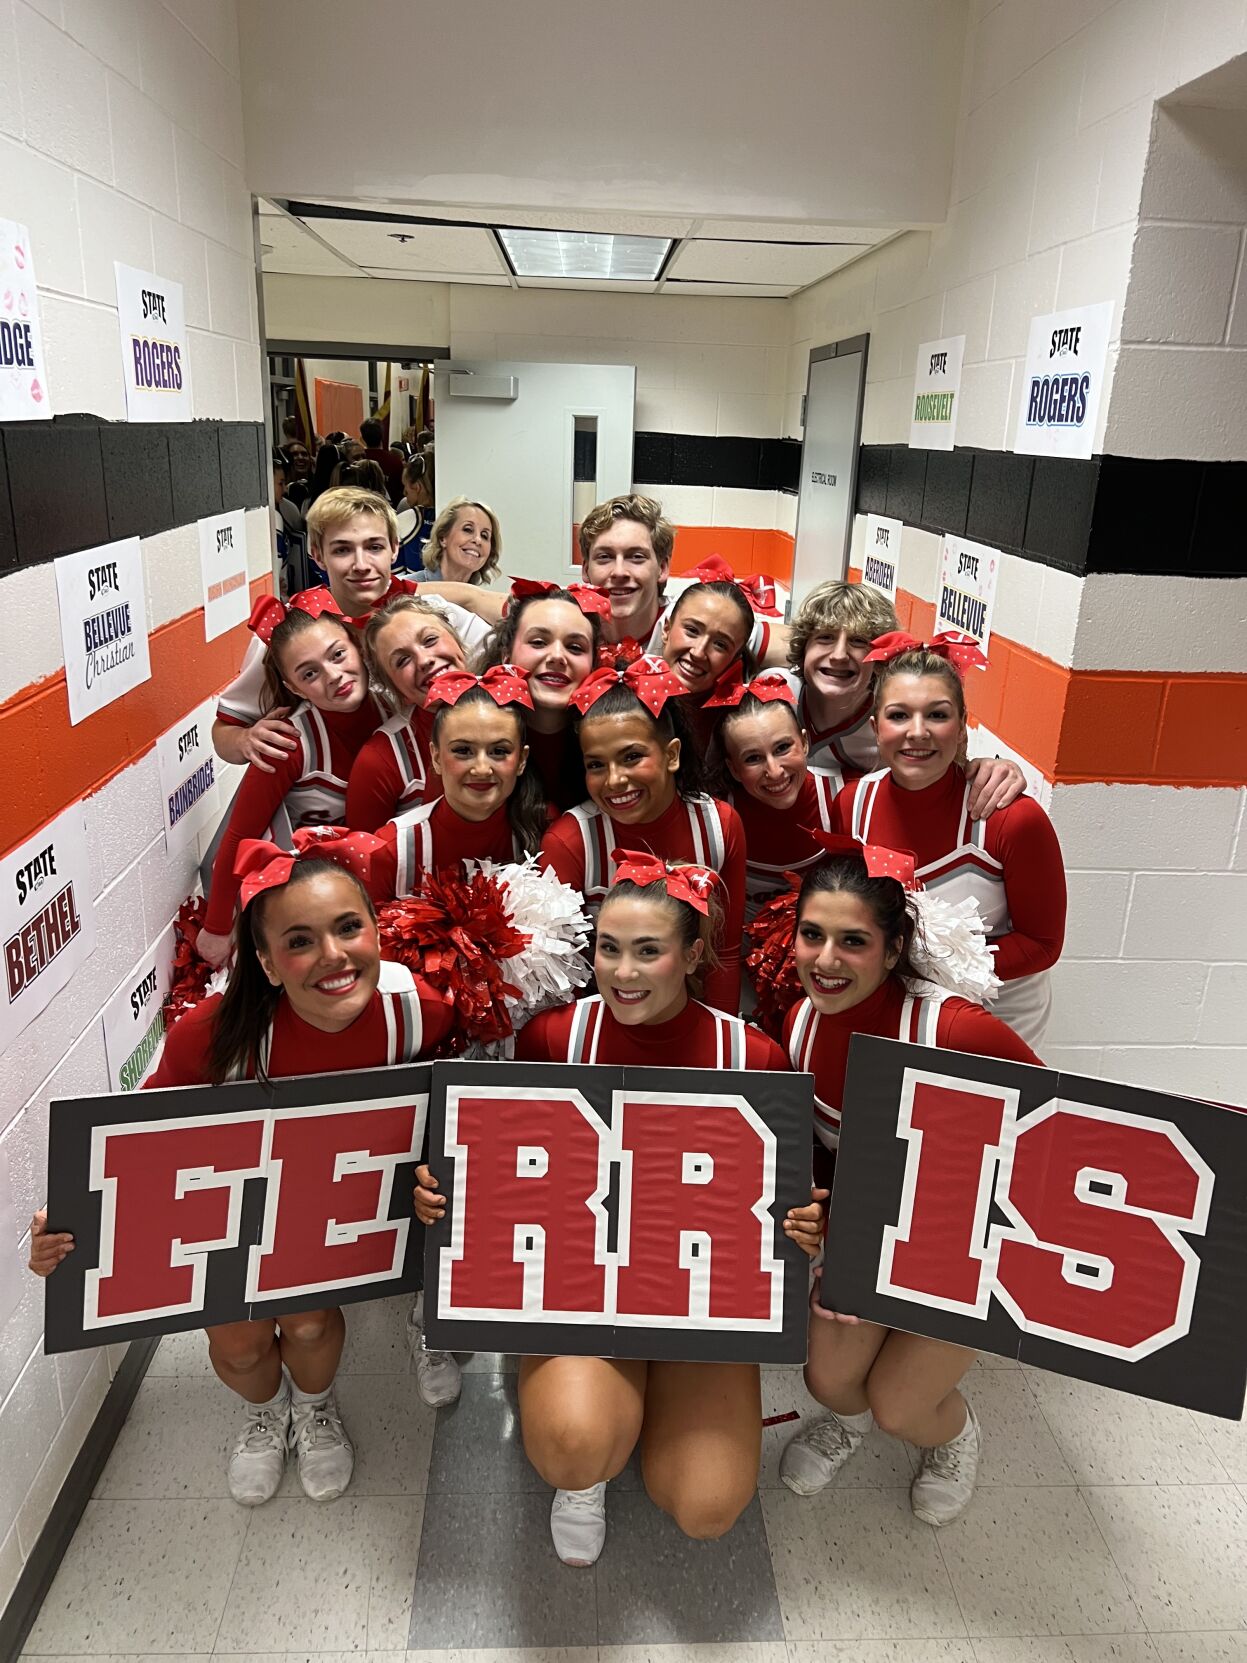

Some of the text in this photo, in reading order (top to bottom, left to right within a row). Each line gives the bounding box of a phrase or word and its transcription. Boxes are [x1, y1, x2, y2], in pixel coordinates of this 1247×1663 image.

[141, 289, 167, 325] STATE
[929, 352, 947, 375] STATE
[1050, 326, 1081, 358] STATE
[132, 338, 182, 390] ROGERS
[914, 392, 955, 421] ROOSEVELT
[1028, 375, 1090, 423] ROGERS
[216, 526, 234, 553] STATE
[875, 527, 890, 549] STATE
[88, 562, 119, 601] STATE
[864, 556, 895, 591] ABERDEEN
[957, 552, 979, 581] STATE
[84, 603, 131, 653] BELLEVUE
[940, 585, 987, 639] BELLEVUE
[86, 641, 134, 689] Christian
[178, 724, 199, 763] STATE
[168, 757, 215, 827] BAINBRIDGE
[15, 843, 57, 906] STATE
[5, 885, 79, 998] BETHEL
[130, 967, 157, 1021] STATE
[119, 1006, 165, 1092] SHOREWO
